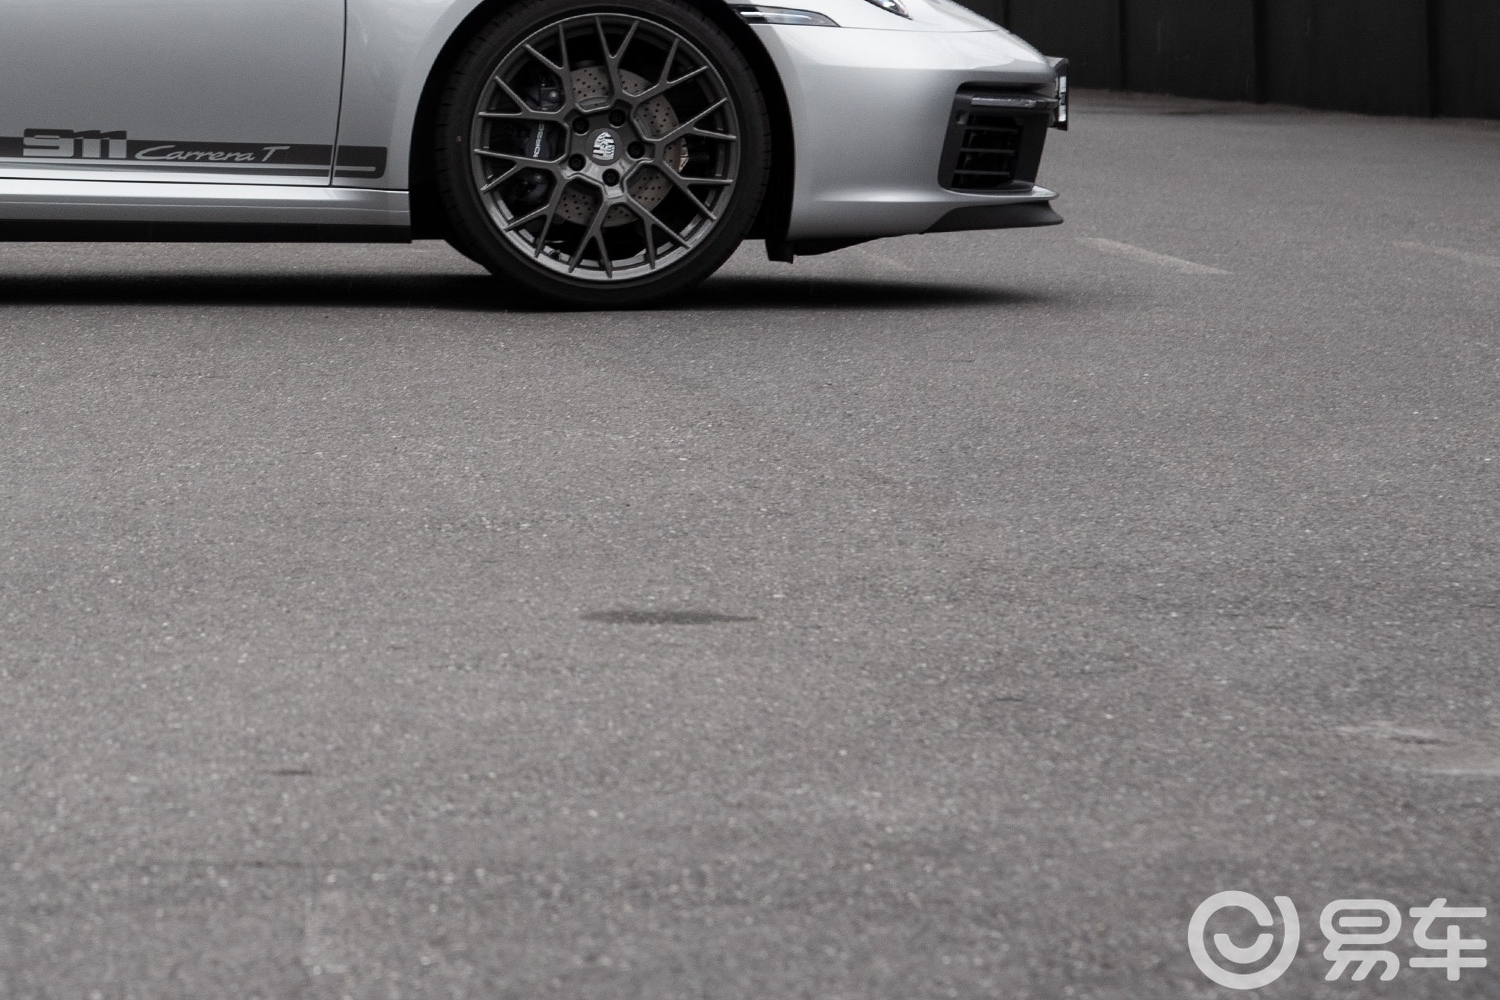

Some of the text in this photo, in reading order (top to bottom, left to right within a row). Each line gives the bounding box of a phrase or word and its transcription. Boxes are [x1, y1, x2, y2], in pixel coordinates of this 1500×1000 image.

[23, 128, 291, 162] 911 Carrera T
